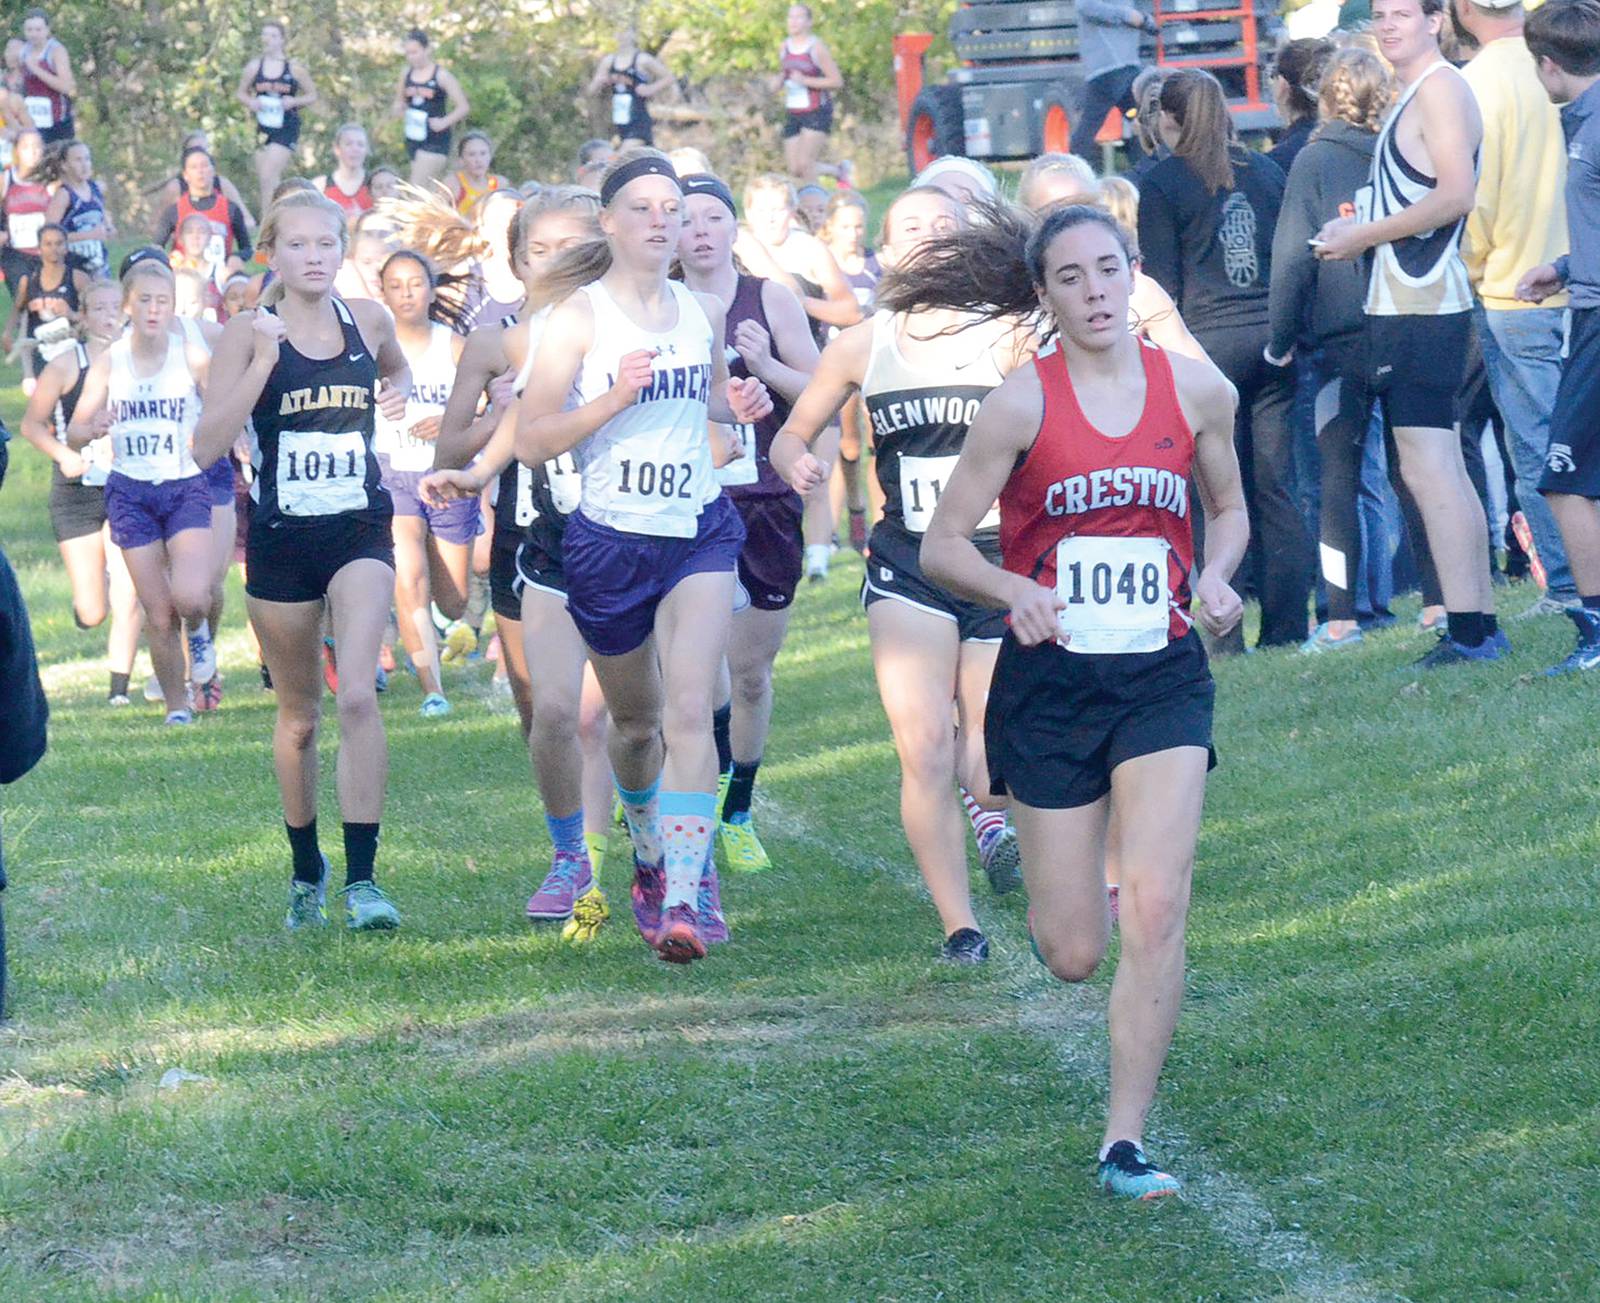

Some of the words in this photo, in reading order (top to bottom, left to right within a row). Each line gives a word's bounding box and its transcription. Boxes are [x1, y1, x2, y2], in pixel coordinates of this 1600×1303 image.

[279, 384, 369, 416] ATLANTIC
[606, 364, 713, 405] NARCH
[871, 397, 981, 436] GLENWOO
[125, 433, 174, 457] 1074
[286, 448, 358, 482] 1011
[617, 459, 693, 499] 1082
[1044, 466, 1188, 519] CRESTON
[1068, 560, 1160, 605] 1048
